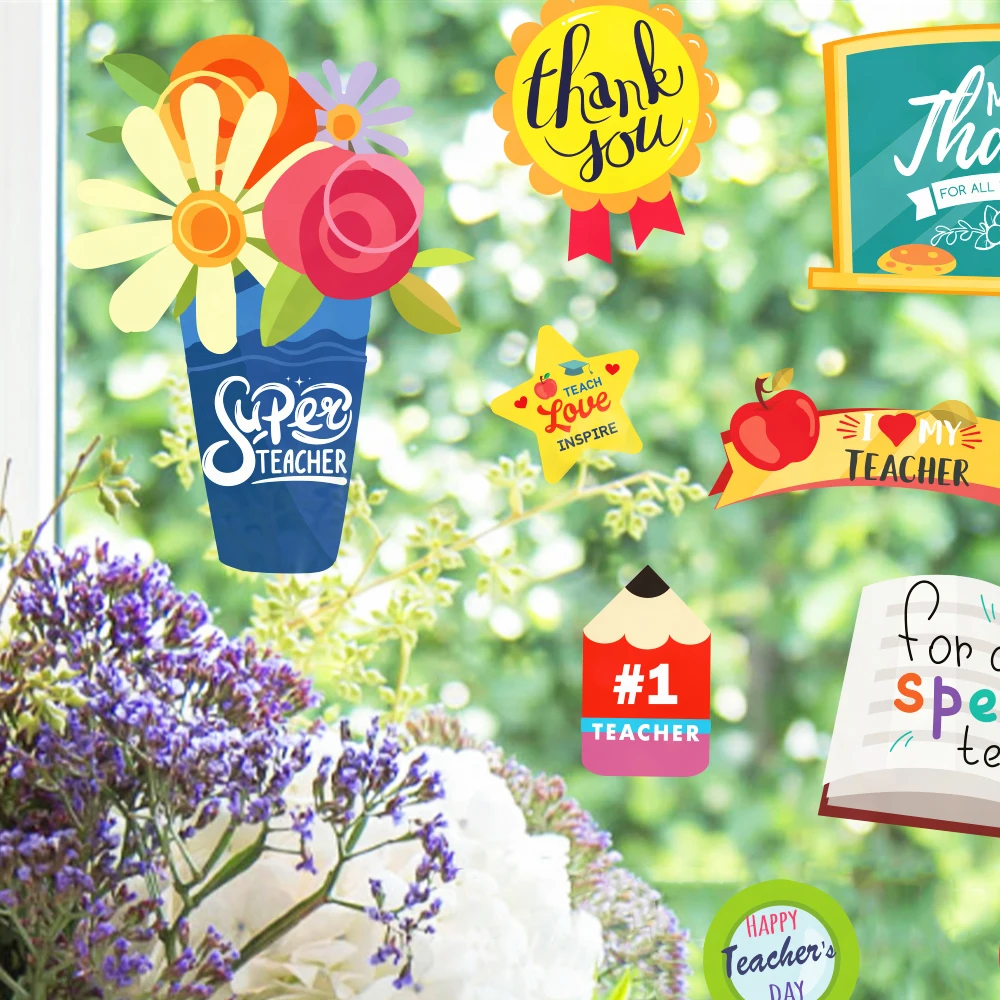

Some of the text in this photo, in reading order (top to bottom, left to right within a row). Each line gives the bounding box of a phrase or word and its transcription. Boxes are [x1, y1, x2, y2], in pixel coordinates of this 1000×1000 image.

[522, 20, 684, 129] thank
[544, 114, 684, 183] you
[939, 185, 967, 200] FOR
[970, 182, 995, 195] ALL
[563, 376, 603, 398] TEACH
[536, 391, 611, 434] Love
[861, 413, 963, 447] I MY
[556, 421, 619, 452] INSPIRE
[255, 448, 348, 475] TEACHER
[845, 448, 970, 487] TEACHER
[898, 579, 973, 668] for
[613, 663, 678, 705] #1
[592, 722, 700, 742] TEACHER
[745, 909, 798, 938] HAPPY
[720, 935, 837, 979] Teacher's
